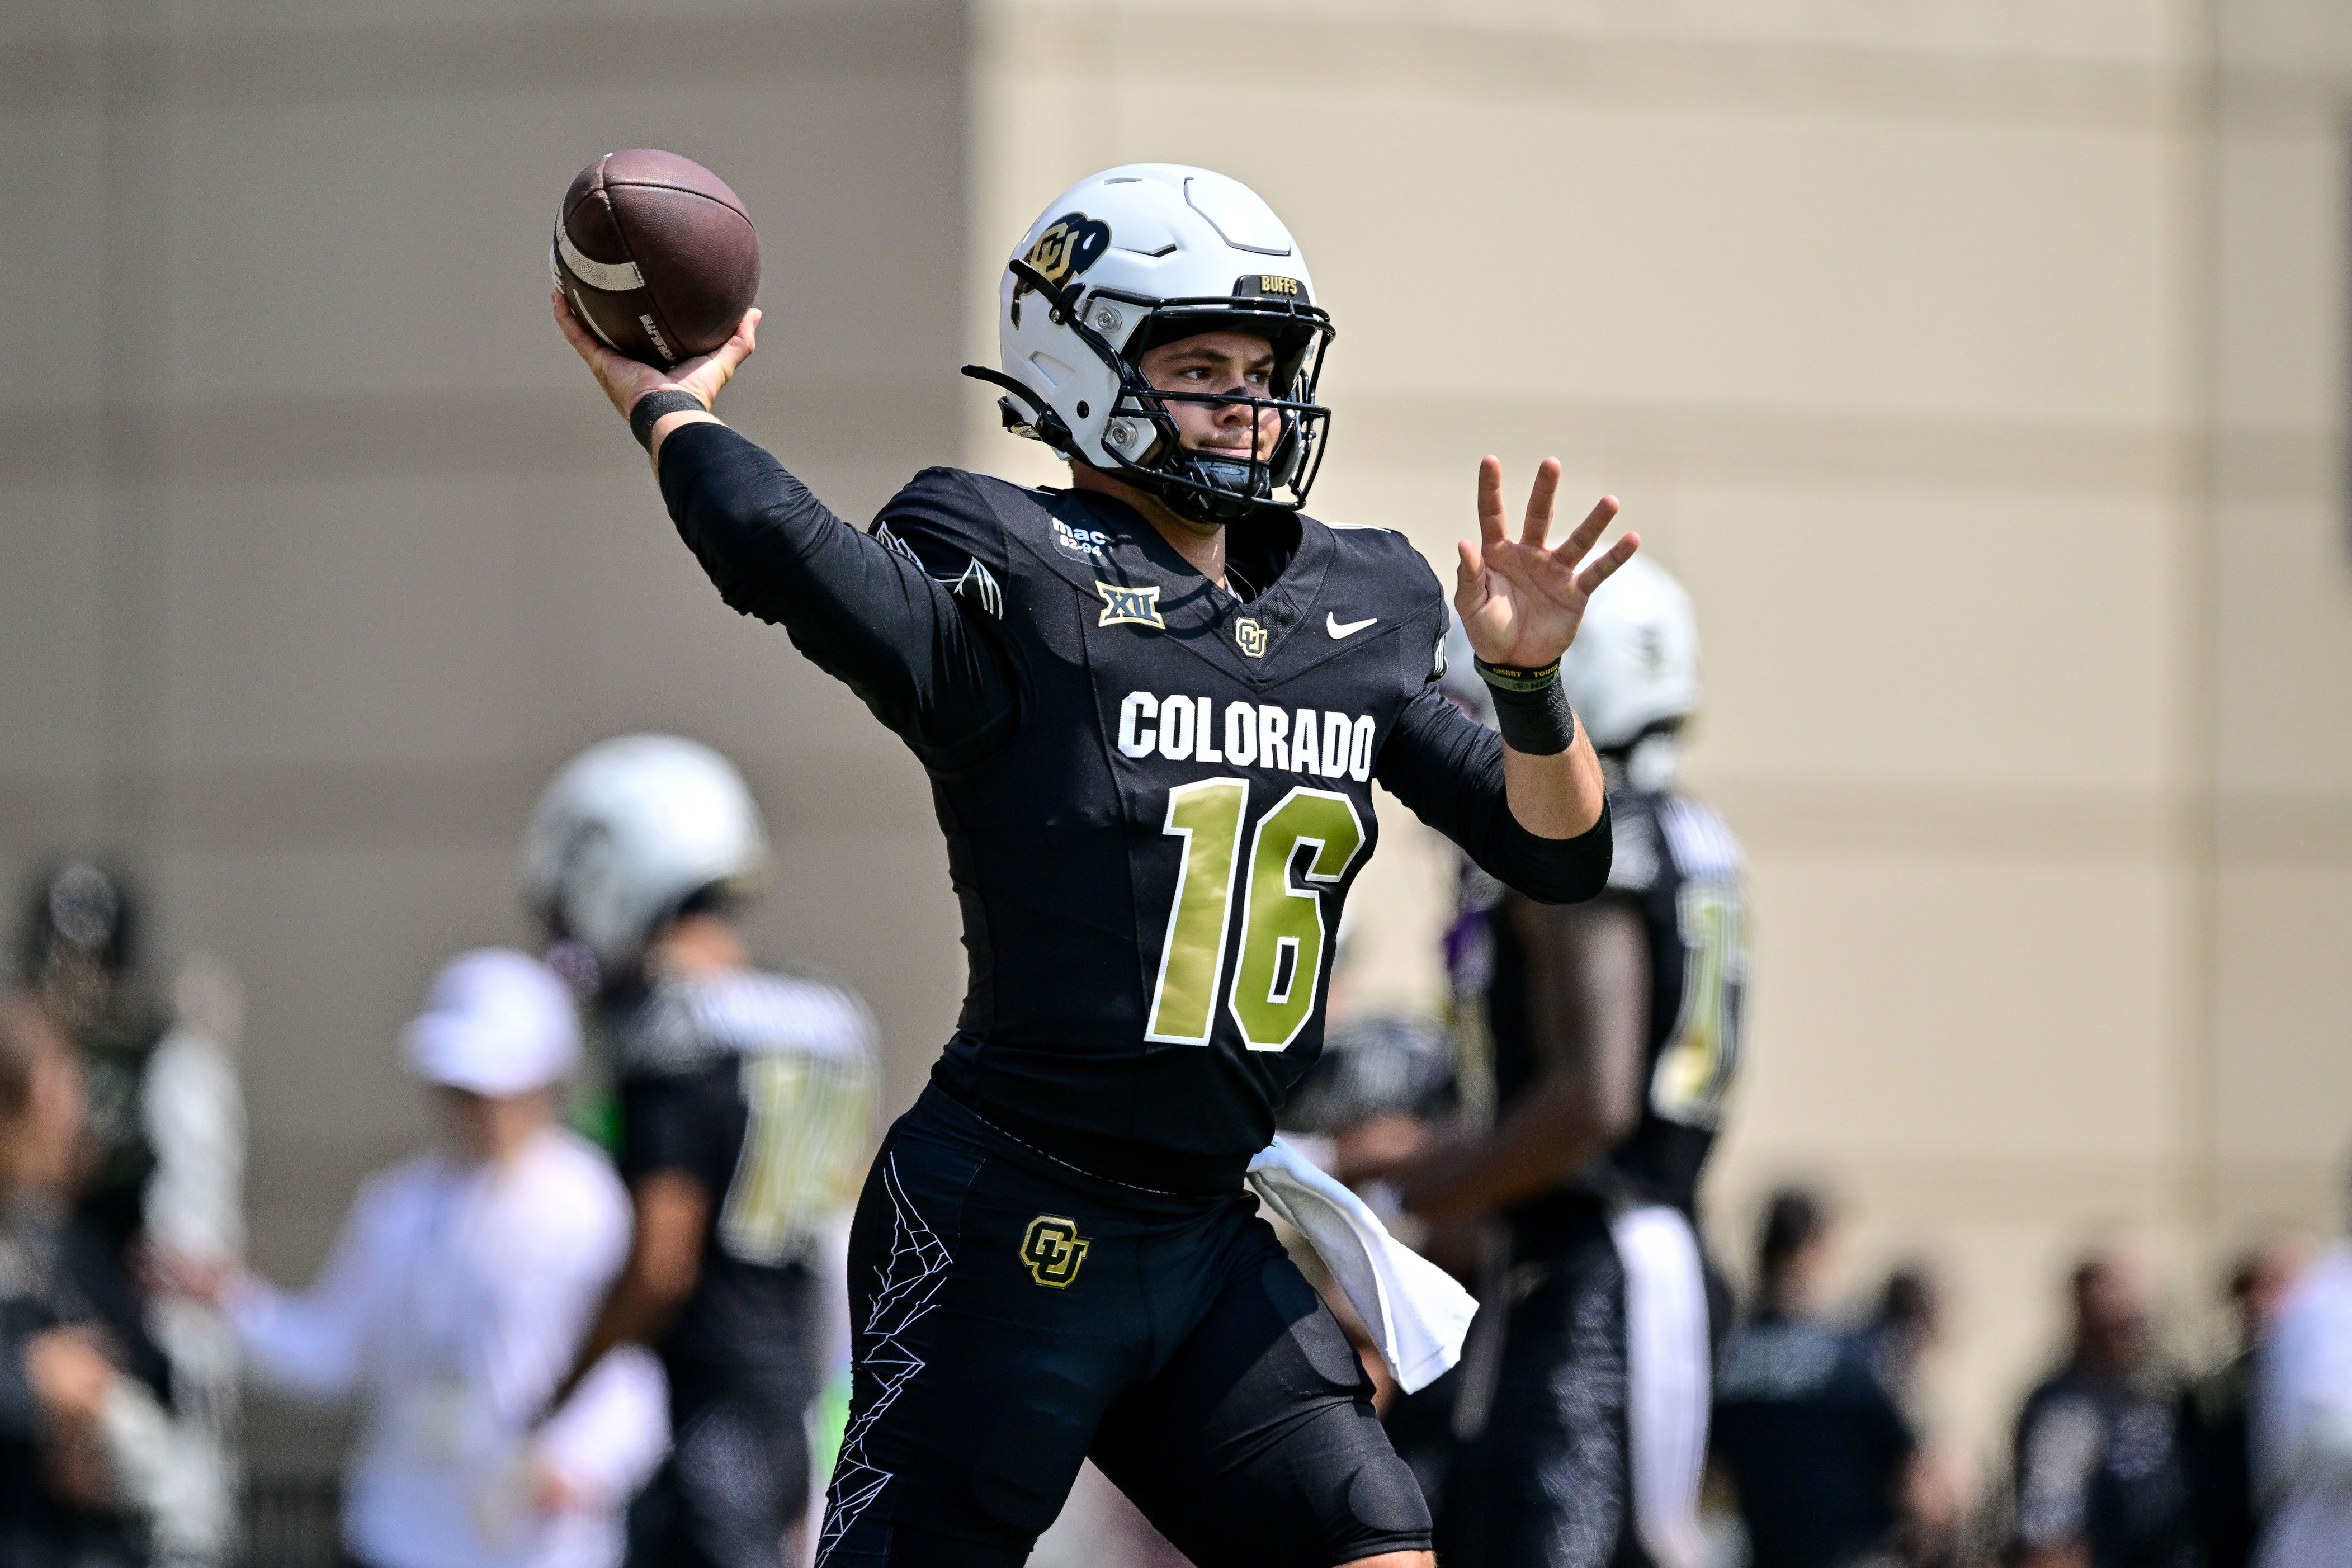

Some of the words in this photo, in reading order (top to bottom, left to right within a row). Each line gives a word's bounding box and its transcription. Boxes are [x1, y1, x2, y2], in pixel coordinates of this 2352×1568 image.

[1261, 275, 1297, 295] BUFFS
[1052, 517, 1106, 545] mac
[1060, 534, 1102, 557] 82-94
[1102, 588, 1159, 622] XII
[1236, 617, 1268, 658] CU
[1118, 691, 1375, 782] COLORADO
[1144, 777, 1365, 1052] 16
[1019, 1215, 1090, 1287] CU
